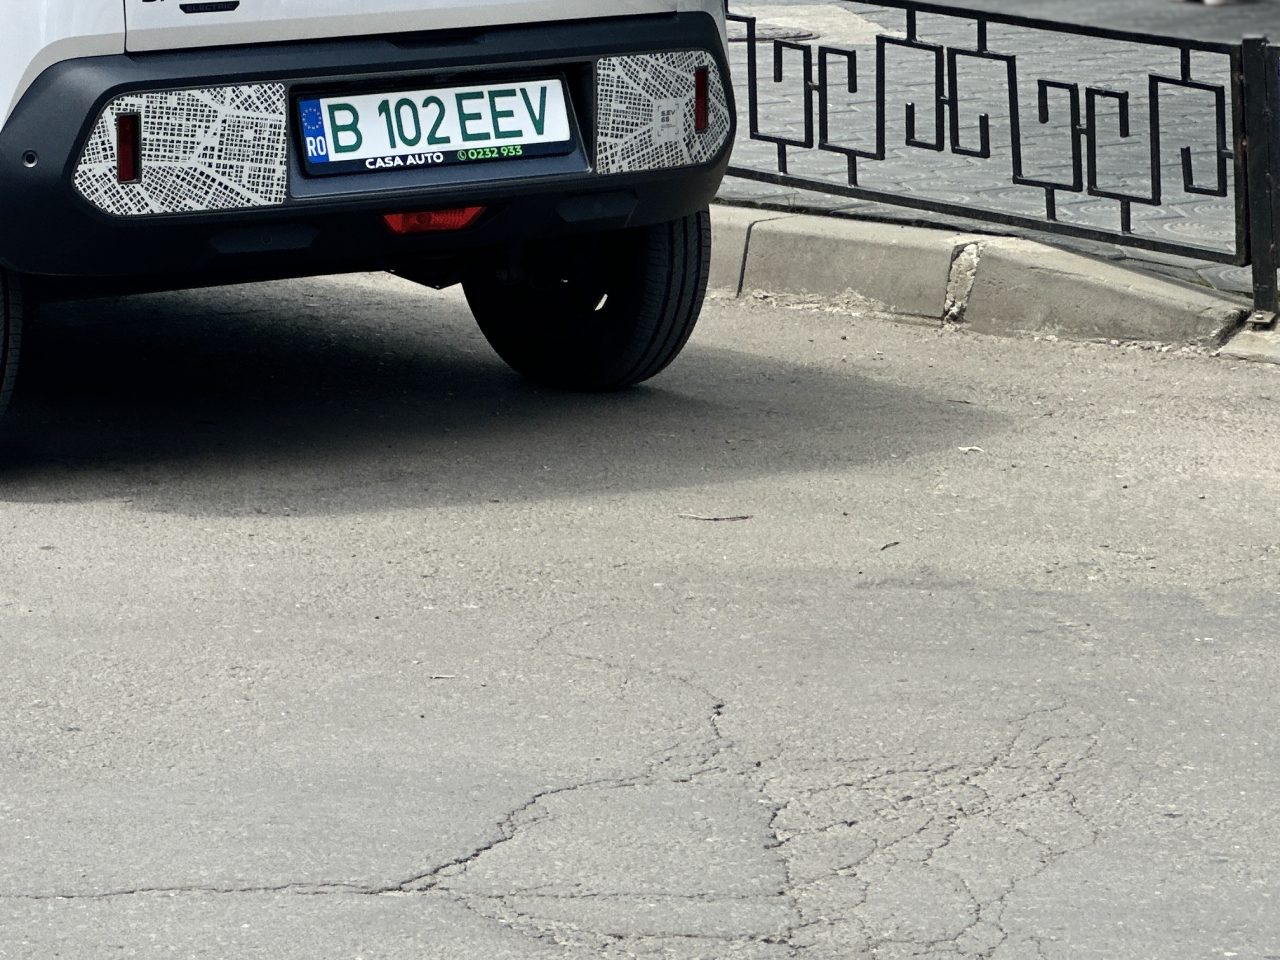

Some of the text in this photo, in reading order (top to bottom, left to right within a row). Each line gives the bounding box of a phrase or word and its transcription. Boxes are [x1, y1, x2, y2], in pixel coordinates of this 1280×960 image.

[326, 85, 548, 154] B 102 EEV
[307, 135, 327, 157] RO
[467, 145, 523, 160] 0232 933
[364, 151, 445, 170] CASA AUTO
